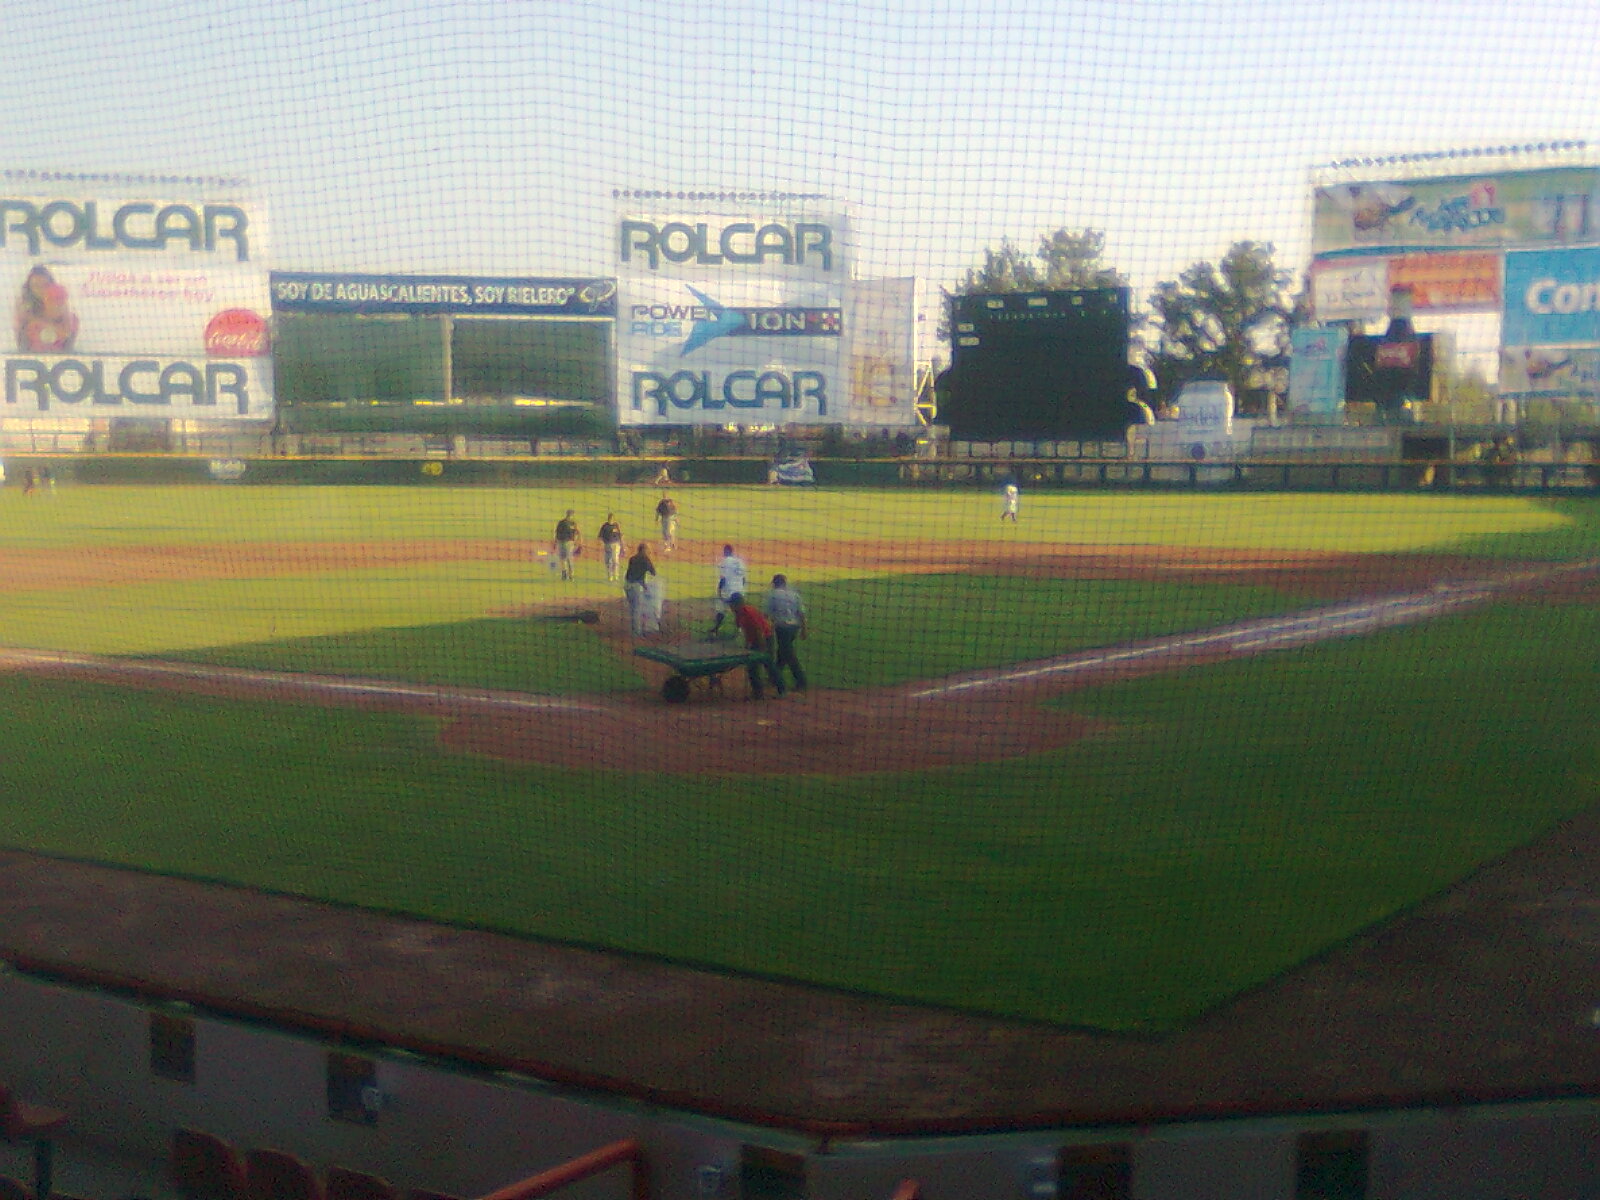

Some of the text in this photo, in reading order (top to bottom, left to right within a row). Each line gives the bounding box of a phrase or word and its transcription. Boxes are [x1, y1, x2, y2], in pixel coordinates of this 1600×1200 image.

[0, 201, 249, 261] ROLCAR
[620, 220, 833, 272] ROLCAR
[312, 283, 333, 300] DE
[475, 286, 504, 304] SOY
[751, 312, 806, 331] ION
[5, 359, 249, 414] ROLCAR
[632, 370, 828, 416] ROLCAR
